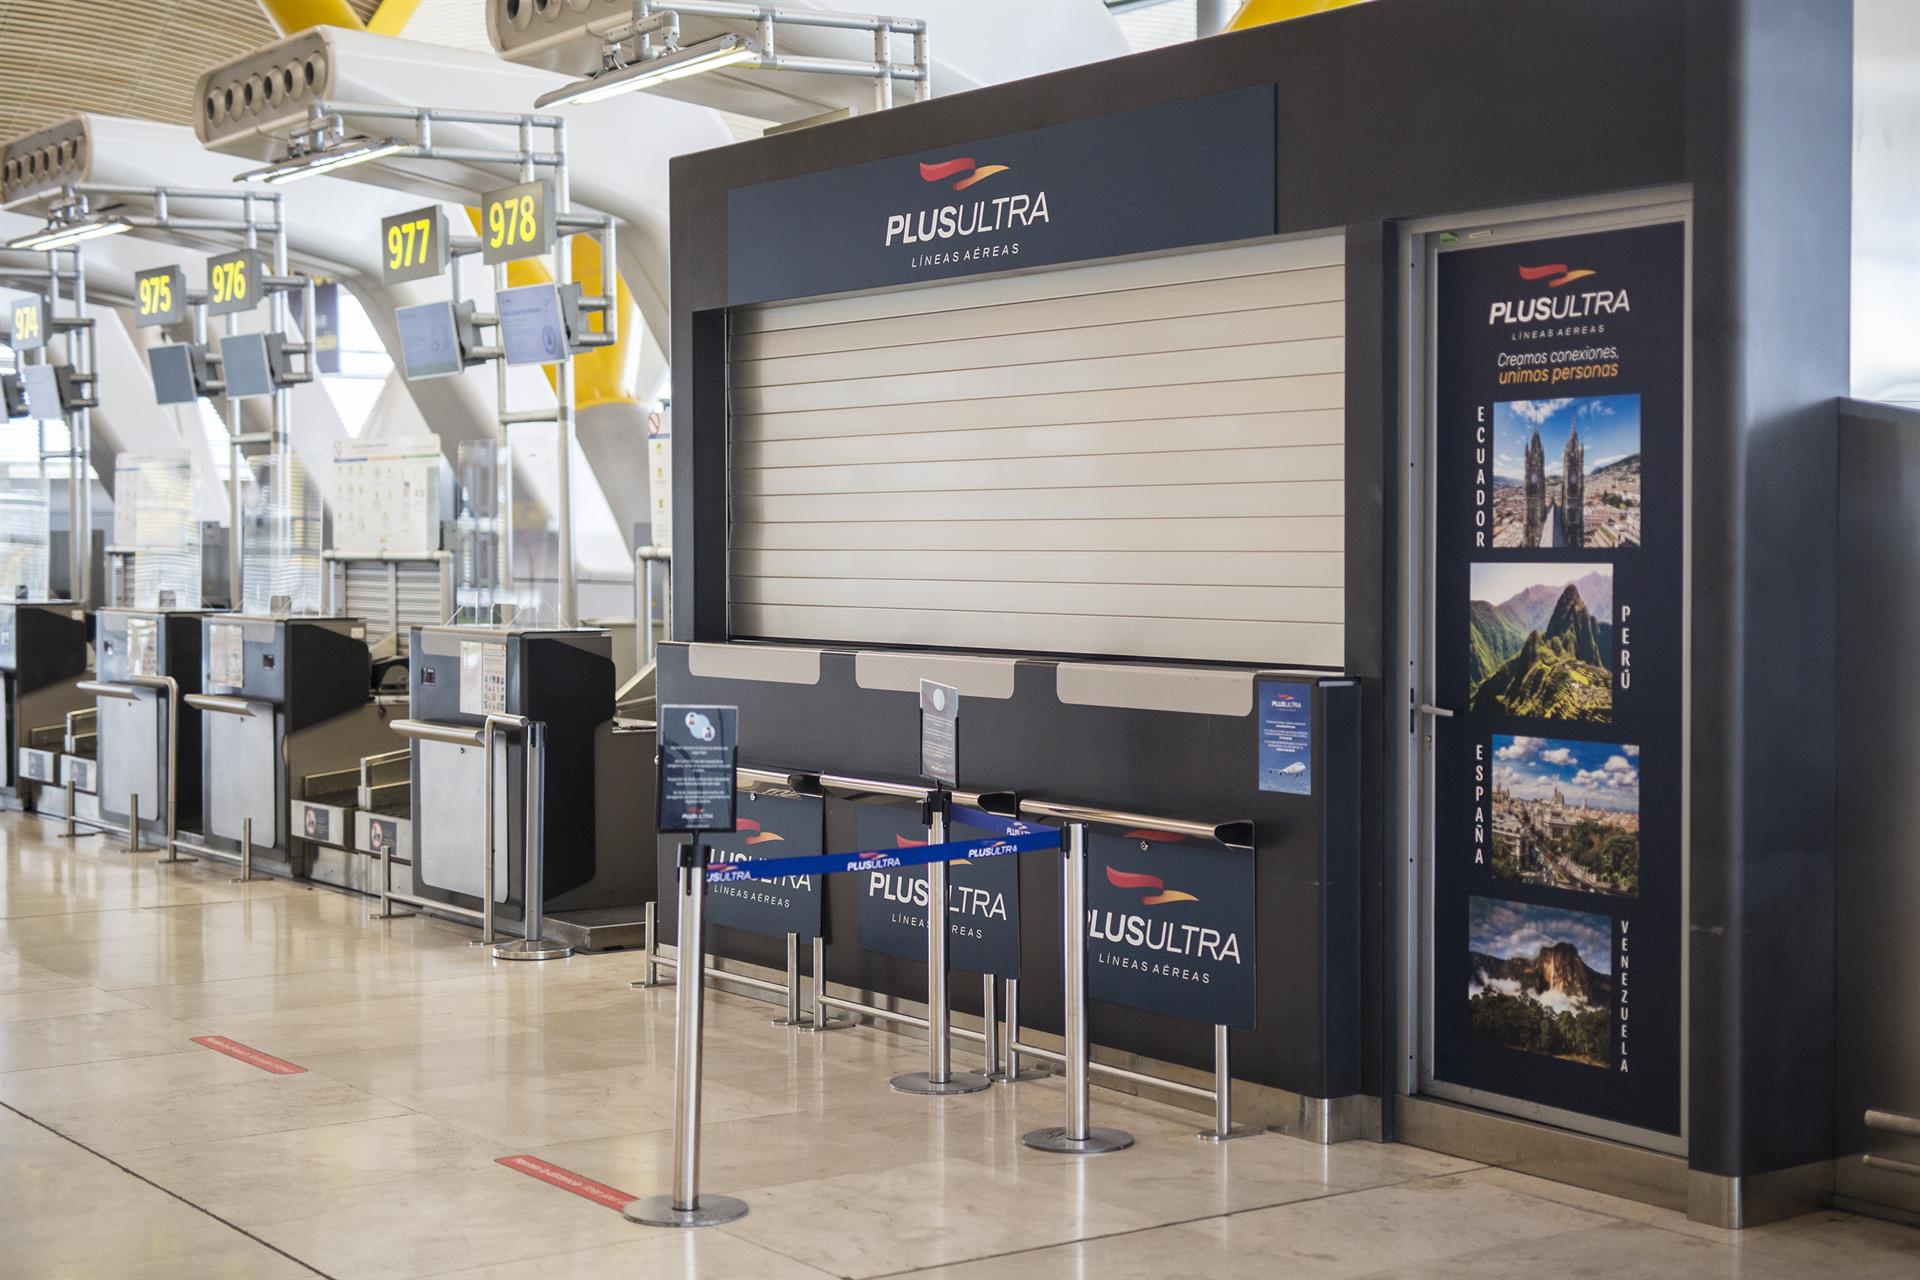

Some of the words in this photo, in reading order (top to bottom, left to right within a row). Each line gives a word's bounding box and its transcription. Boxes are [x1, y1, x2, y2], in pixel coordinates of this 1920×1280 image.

[489, 194, 537, 249] 978
[885, 191, 1050, 247] PLUSULTRA
[388, 218, 431, 270] 977
[911, 252, 960, 268] LÍNEAS
[963, 243, 1020, 261] AÉREAS
[140, 275, 172, 315] 975
[212, 260, 246, 304] 976
[15, 305, 39, 341] 974
[1488, 289, 1631, 325] PLUSULTRA
[1497, 352, 1548, 367] Creamos
[1498, 367, 1549, 384] unimos
[1551, 363, 1619, 384] personas
[1475, 406, 1486, 548] ECUADOR
[1621, 605, 1631, 689] PERÚ
[1475, 744, 1484, 864] ESPAÑA
[847, 858, 901, 871] PLUSULTRA
[714, 884, 748, 899] LÍNEAS
[751, 893, 790, 908] AÉREAS
[869, 871, 1007, 921] PLUSLTRA
[1088, 909, 1241, 965] LUSULTRA
[1098, 953, 1148, 971] LÍNEAS
[1152, 964, 1210, 984] AÉREAS
[1620, 920, 1630, 1073] VENEZUELA
